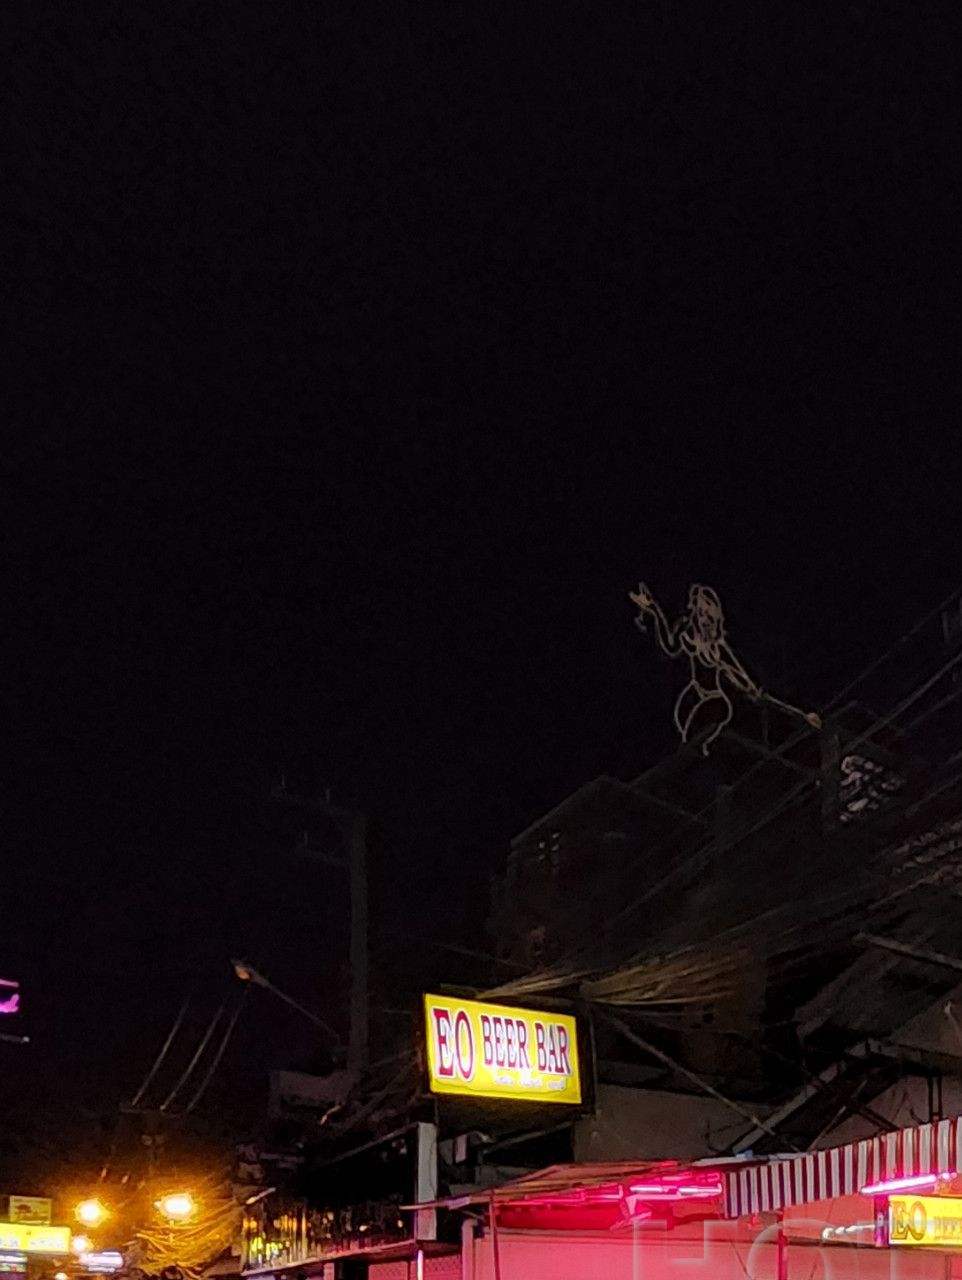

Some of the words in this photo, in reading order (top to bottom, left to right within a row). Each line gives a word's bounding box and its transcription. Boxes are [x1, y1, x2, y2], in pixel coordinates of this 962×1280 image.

[432, 1007, 474, 1080] EO
[480, 1014, 530, 1069] BEER
[535, 1021, 572, 1075] BAR
[891, 1201, 927, 1241] EO
